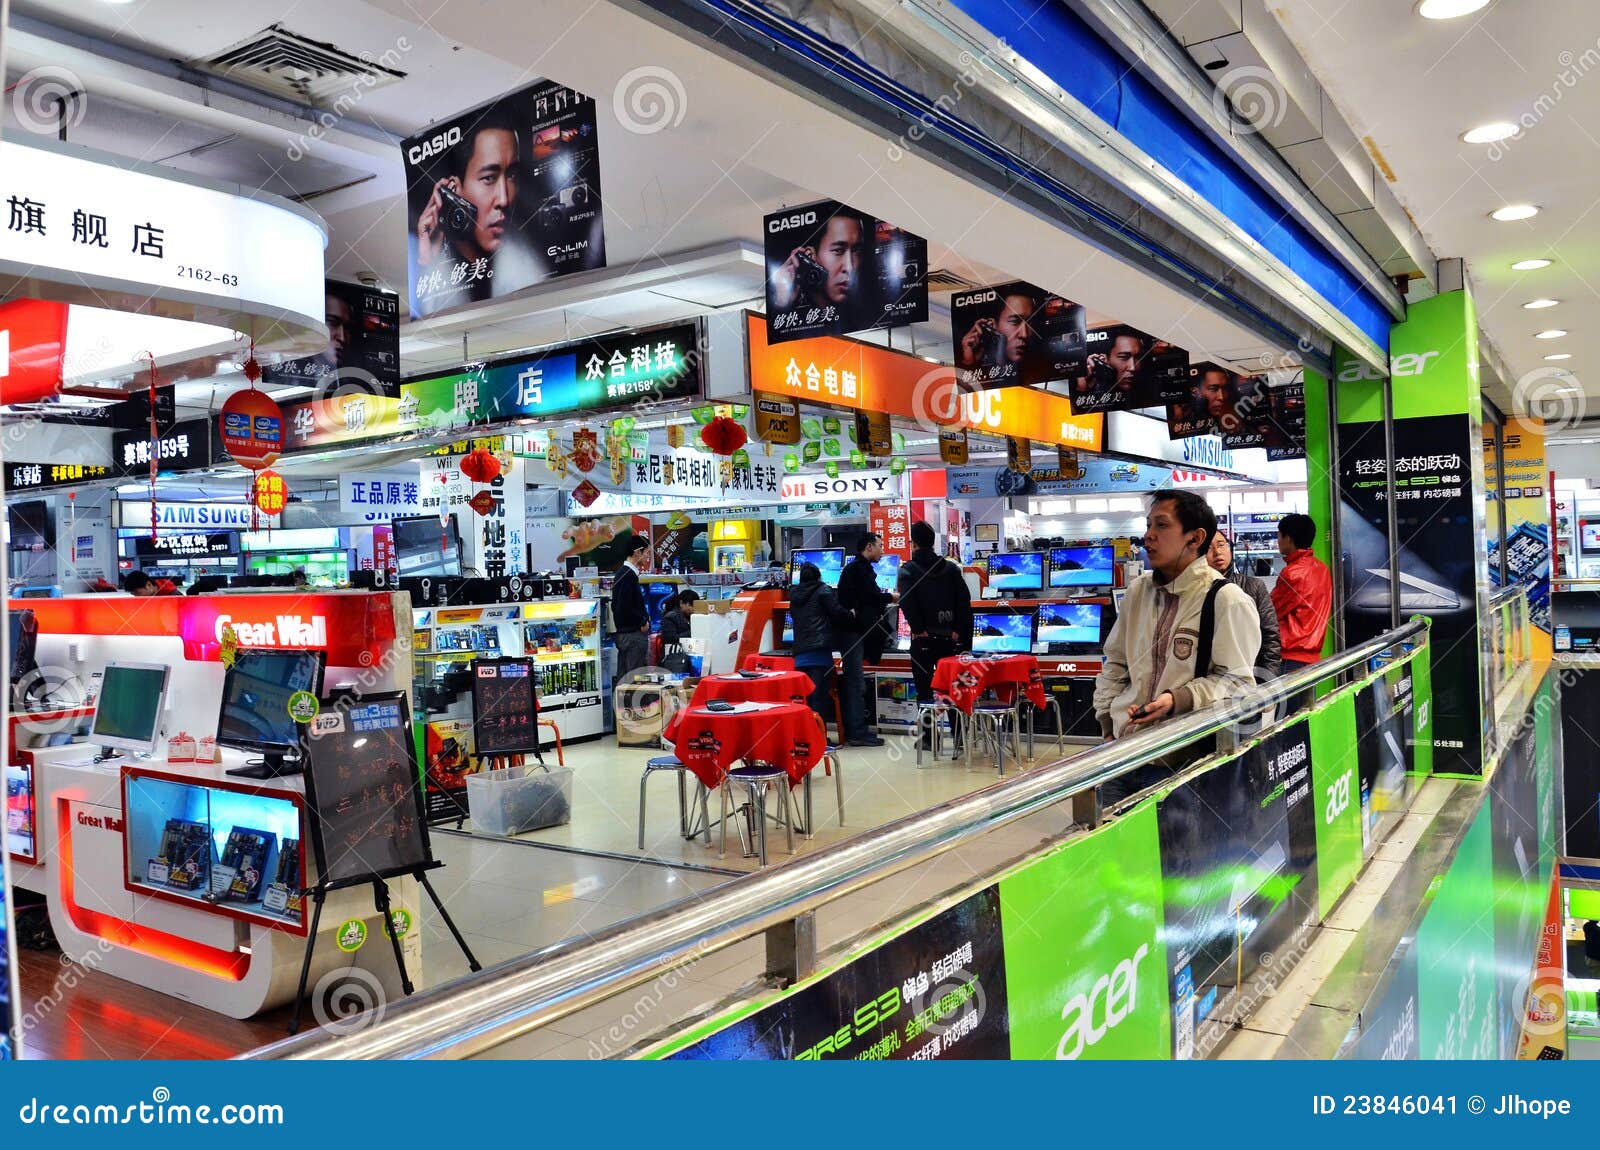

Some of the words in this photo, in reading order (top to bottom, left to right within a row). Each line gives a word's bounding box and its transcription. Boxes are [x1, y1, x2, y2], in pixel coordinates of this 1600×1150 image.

[408, 126, 462, 165] CASIO
[7, 196, 164, 258] 旗舰店
[768, 211, 817, 233] CASIO
[177, 265, 238, 287] 2162-63
[955, 291, 996, 307] CASIO
[1086, 332, 1108, 342] SIO
[584, 340, 677, 382] 众合科技
[785, 357, 857, 398] 众合电脑
[294, 366, 543, 441] 华硕金牌店
[768, 419, 789, 432] AOC
[436, 456, 452, 469] Wii
[814, 477, 889, 495] SONY
[1410, 475, 1440, 486] S3
[351, 481, 418, 505] 正品原装
[150, 506, 250, 524] SAMSUNG
[215, 615, 275, 646] Great
[276, 615, 327, 646] Wall
[1056, 663, 1077, 673] AOC
[575, 695, 597, 707] ASUS
[1326, 768, 1352, 825] acer
[77, 811, 103, 829] Great
[854, 986, 901, 1036] S3
[902, 971, 930, 1004] 蜂鸟
[1055, 943, 1148, 1060] acer
